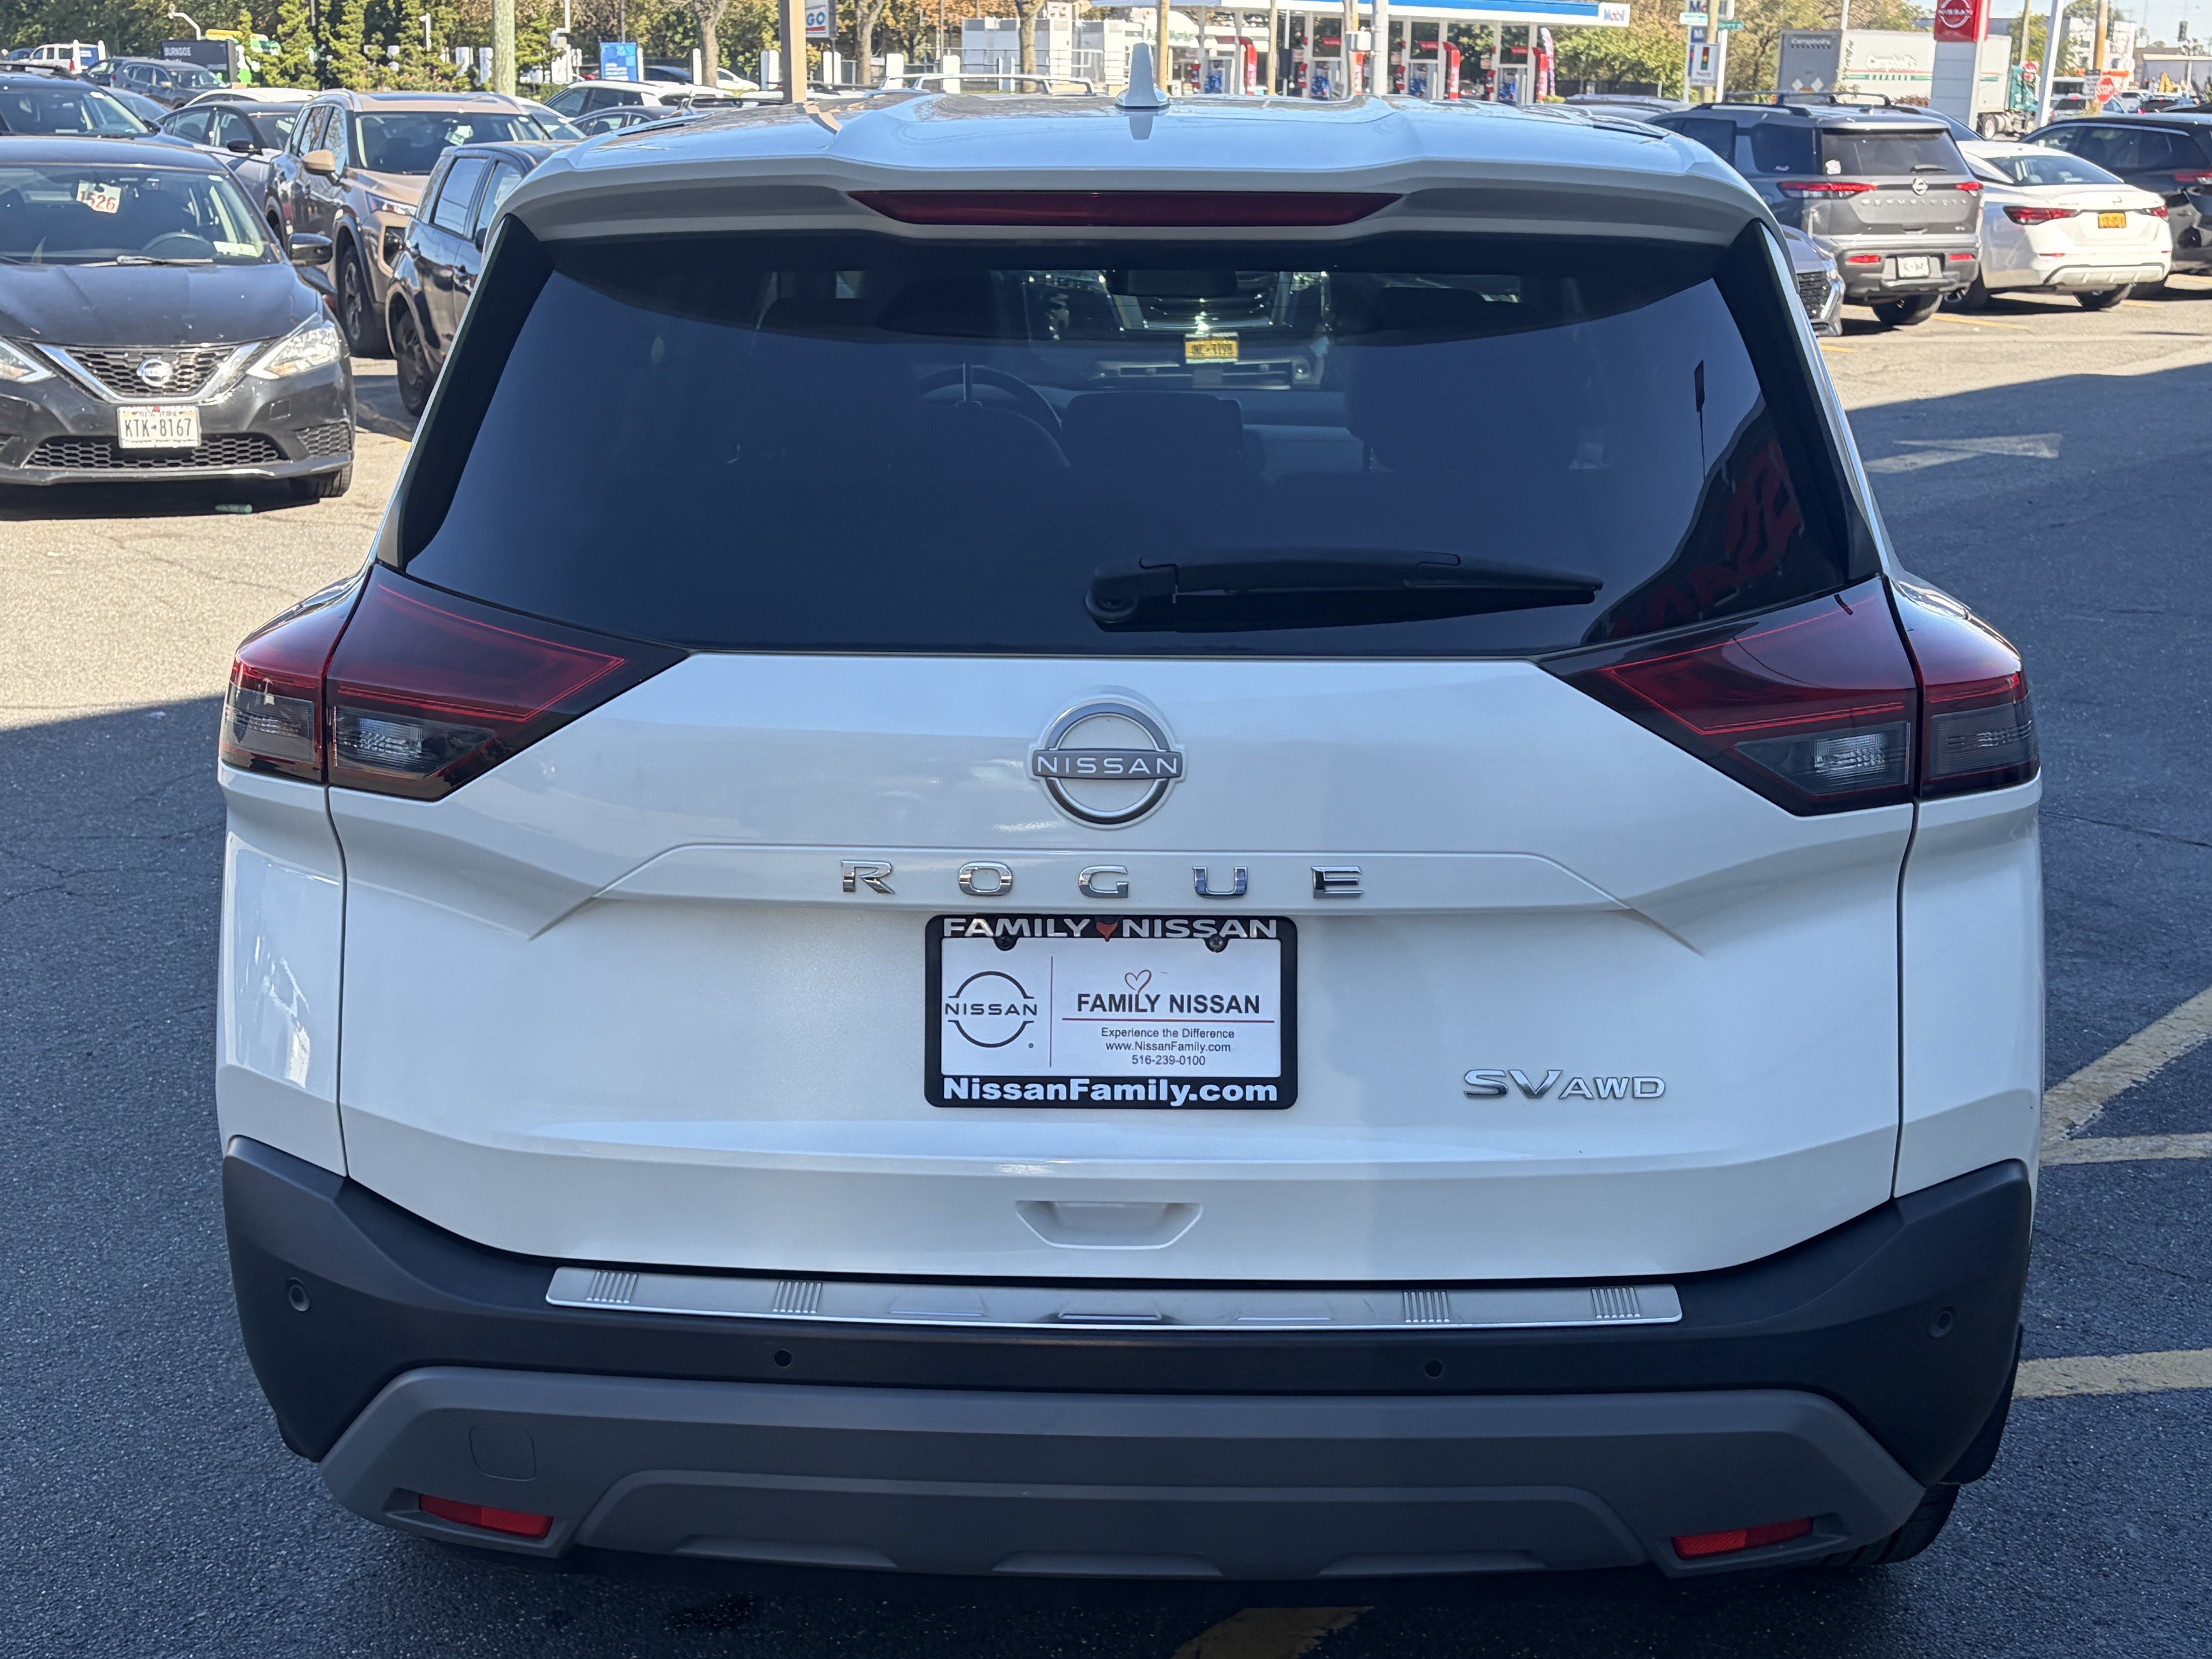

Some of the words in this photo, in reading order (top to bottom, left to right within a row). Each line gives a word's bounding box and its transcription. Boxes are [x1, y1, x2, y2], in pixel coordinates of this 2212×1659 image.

[1037, 756, 1177, 774] NISSAN
[840, 859, 1363, 899] ROGUE
[943, 918, 1091, 937] FAMILY
[1123, 919, 1277, 938] NISSAN
[945, 1003, 1037, 1016] NISSAN
[1077, 993, 1161, 1013] FAMILY
[1169, 994, 1260, 1014] NISSAN
[1101, 1027, 1159, 1039] Experience
[1163, 1028, 1178, 1038] the
[1182, 1028, 1235, 1039] Difference
[1105, 1041, 1231, 1054] www.NissanFamily.com
[1132, 1055, 1206, 1066] 516-239-0100
[943, 1077, 1277, 1106] NissanFamily.com
[1463, 1068, 1563, 1099] SV
[1558, 1076, 1666, 1100] AWD
